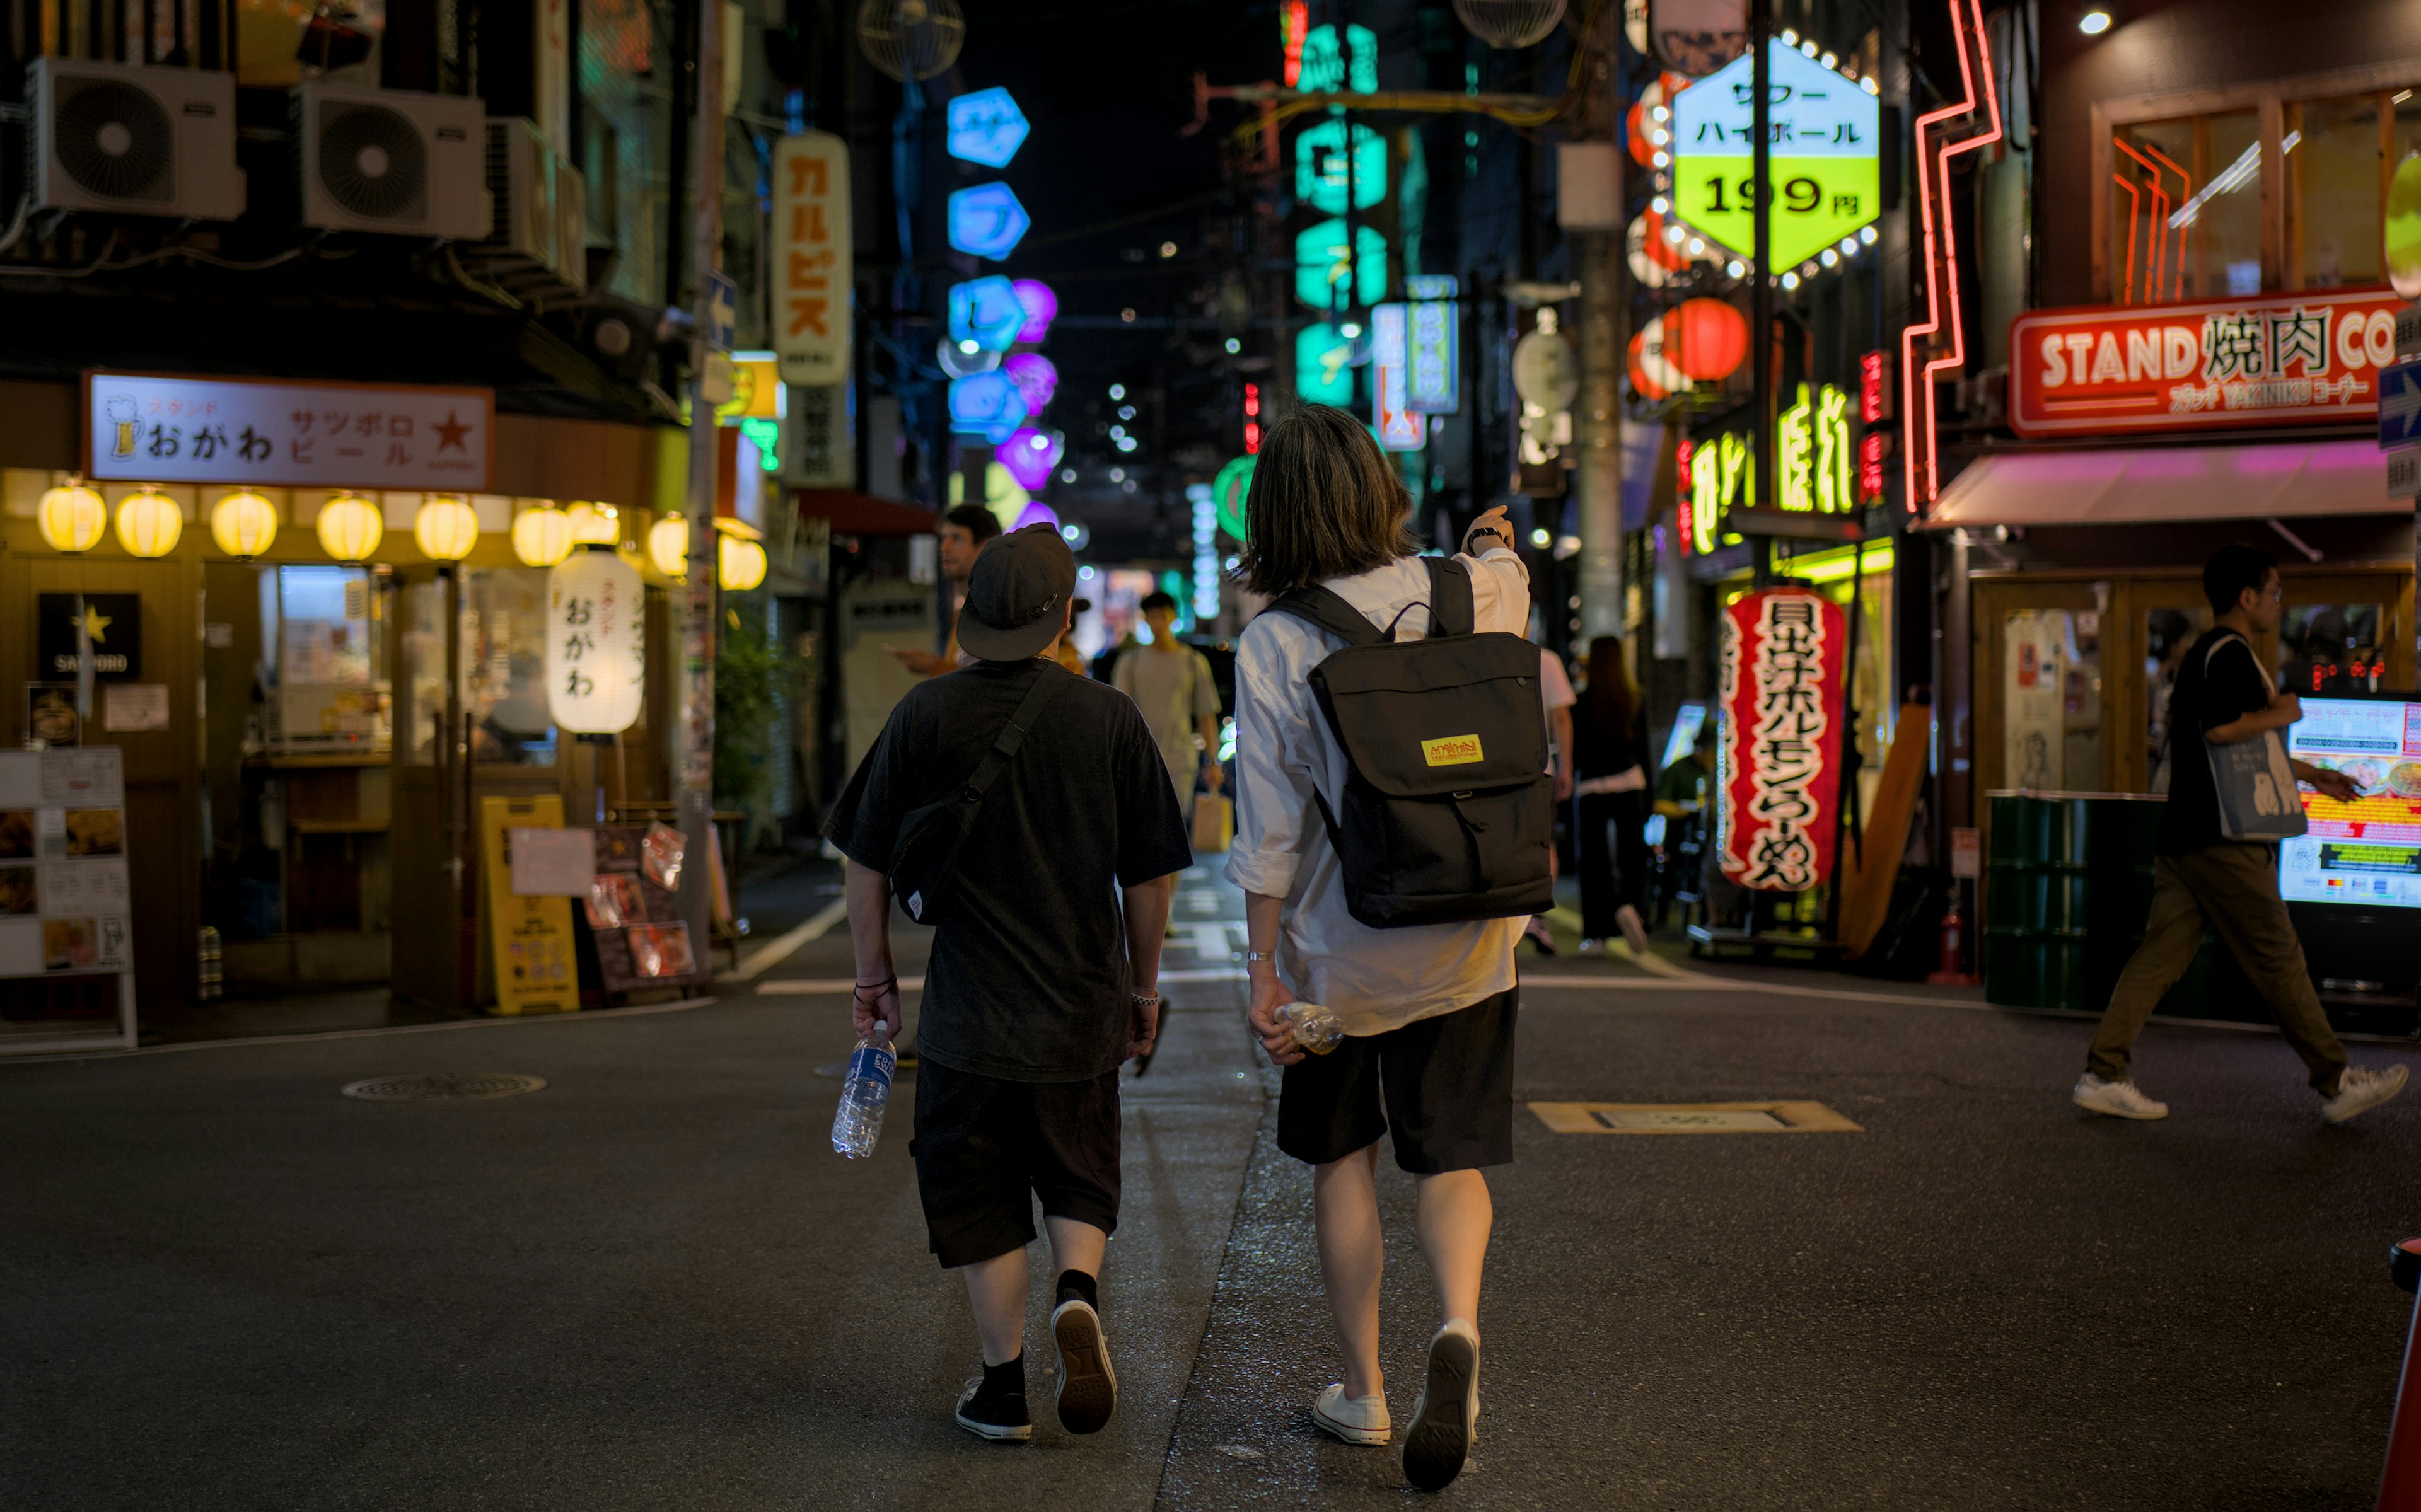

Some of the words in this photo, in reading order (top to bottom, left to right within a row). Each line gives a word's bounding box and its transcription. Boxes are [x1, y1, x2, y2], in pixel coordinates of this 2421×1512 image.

[1697, 117, 1861, 144] ハイボール
[1833, 195, 1859, 216] 円
[788, 155, 836, 339] カルピス
[2041, 325, 2199, 388] STAND
[2204, 306, 2334, 379] 焼肉
[2223, 379, 2312, 408] YAKINIKU
[2313, 372, 2369, 406] コーナー
[147, 395, 219, 418] スタンド
[148, 421, 273, 464] おがわ
[290, 441, 414, 466] ビール
[565, 596, 595, 696] おがわ
[54, 654, 128, 672] SAORO
